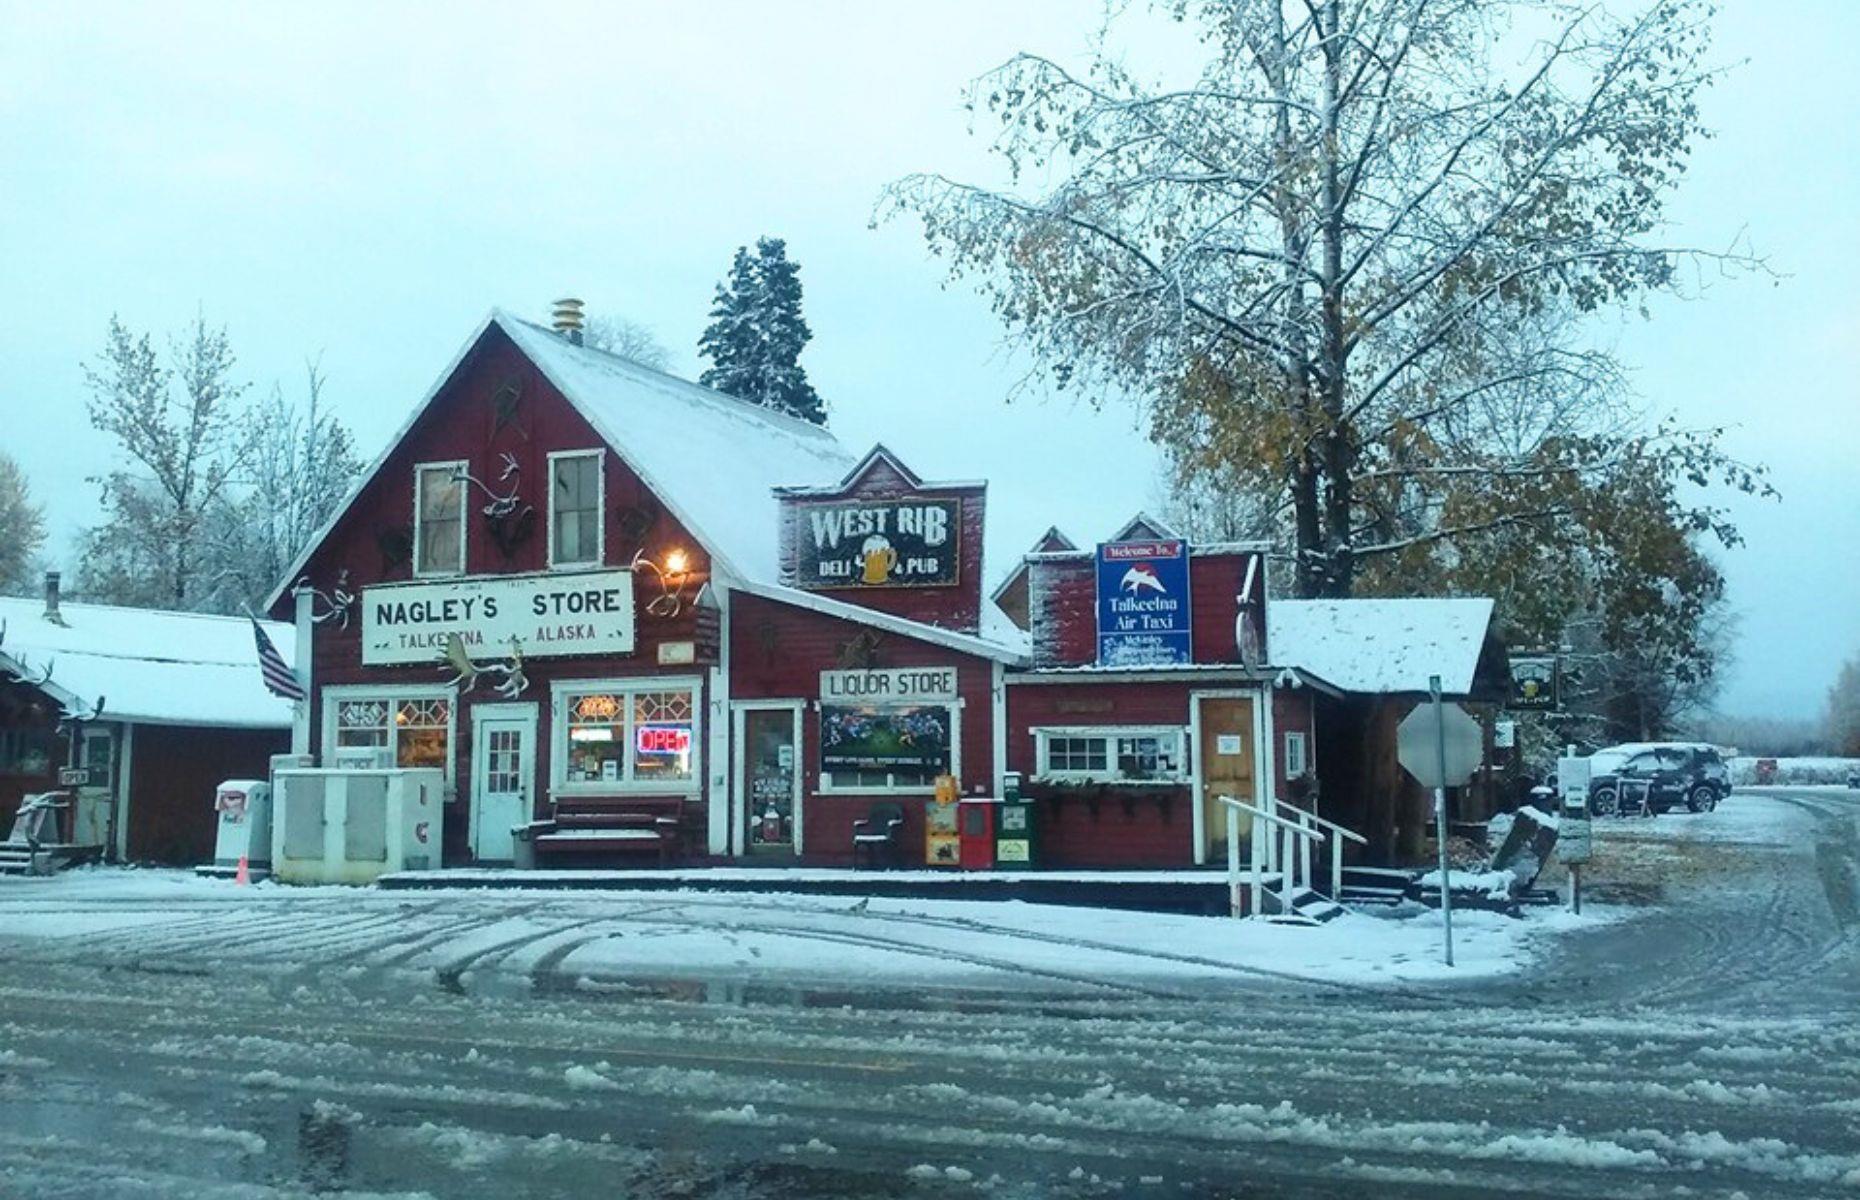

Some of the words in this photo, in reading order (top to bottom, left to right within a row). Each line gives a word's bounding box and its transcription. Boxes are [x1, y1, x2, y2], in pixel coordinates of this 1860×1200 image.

[811, 507, 890, 549] WEST
[897, 505, 947, 547] RIB
[819, 560, 850, 577] DELI
[907, 557, 939, 575] PUB
[376, 594, 498, 625] NAGLEY'S
[532, 589, 620, 616] STORE
[1109, 596, 1178, 612] Talkeetna
[1115, 615, 1137, 630] Air
[1141, 613, 1173, 629] Taxi
[399, 630, 483, 649] TALKENA
[536, 624, 596, 642] ALASKA
[830, 674, 890, 696] LIQUOR
[898, 672, 952, 694] STORE
